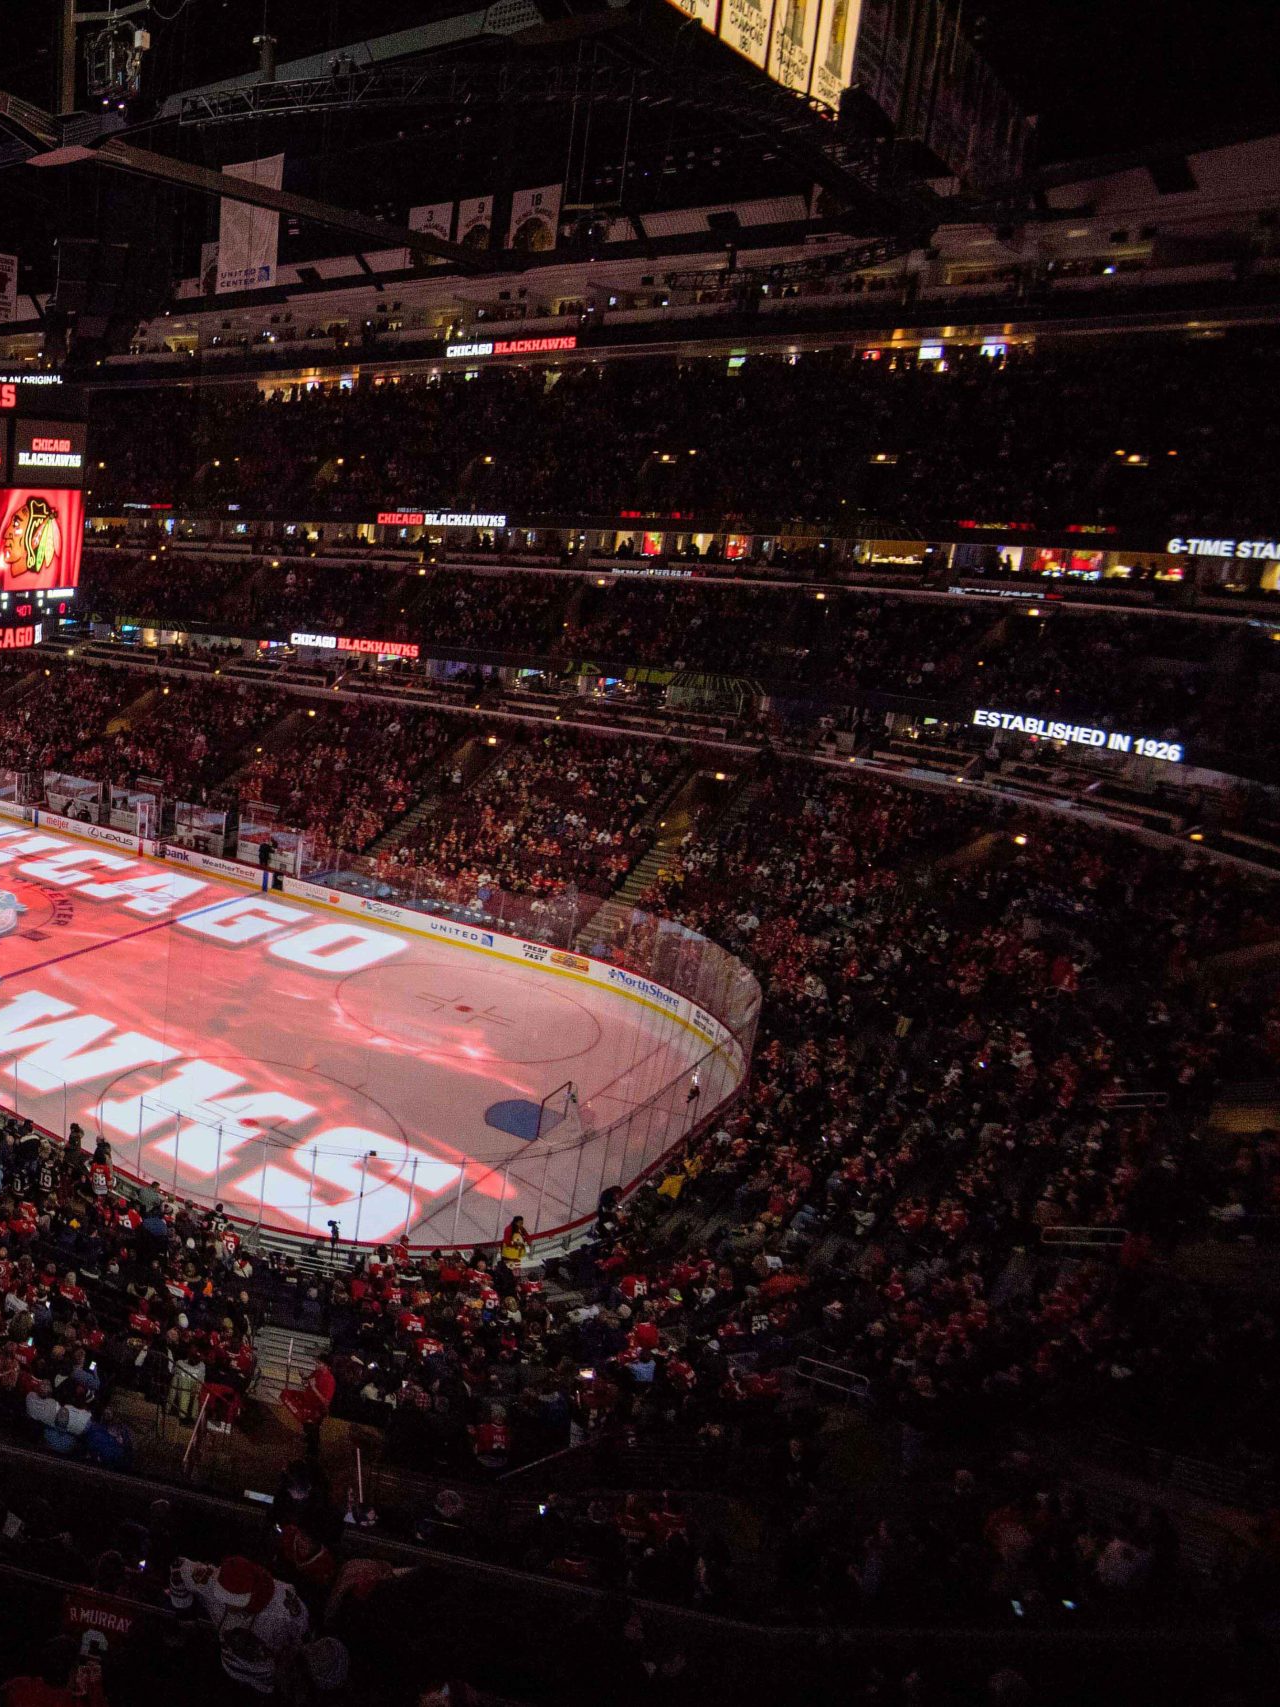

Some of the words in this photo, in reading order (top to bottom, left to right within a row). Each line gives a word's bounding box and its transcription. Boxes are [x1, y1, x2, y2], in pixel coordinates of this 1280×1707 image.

[531, 193, 542, 207] 18
[477, 202, 485, 214] 9
[426, 210, 434, 222] 3
[221, 268, 256, 279] UNITED
[220, 277, 256, 287] CENTER
[447, 343, 492, 358] CHICAGO
[494, 337, 576, 354] BLACKHAWKS
[32, 438, 70, 452] CHICAGO
[18, 453, 81, 467] BLACKHAWKS
[377, 513, 423, 525] CHICAGO
[424, 513, 506, 527] BLACKHAWKS
[1167, 538, 1234, 557] 6-TIME
[291, 632, 336, 649] CHICAGO
[337, 637, 419, 658] BLACKHAWKS
[973, 709, 1105, 748] ESTABLISHED
[1108, 732, 1131, 752] IN
[1133, 738, 1183, 762] 1926
[46, 816, 69, 830] meijer
[100, 832, 134, 846] LEXUS
[202, 858, 256, 878] WeatherTech
[430, 922, 478, 941] UNITED
[522, 943, 549, 955] FRESH
[524, 952, 544, 962] FAST
[618, 970, 680, 1007] NorthShore
[39, 1171, 53, 1188] 19
